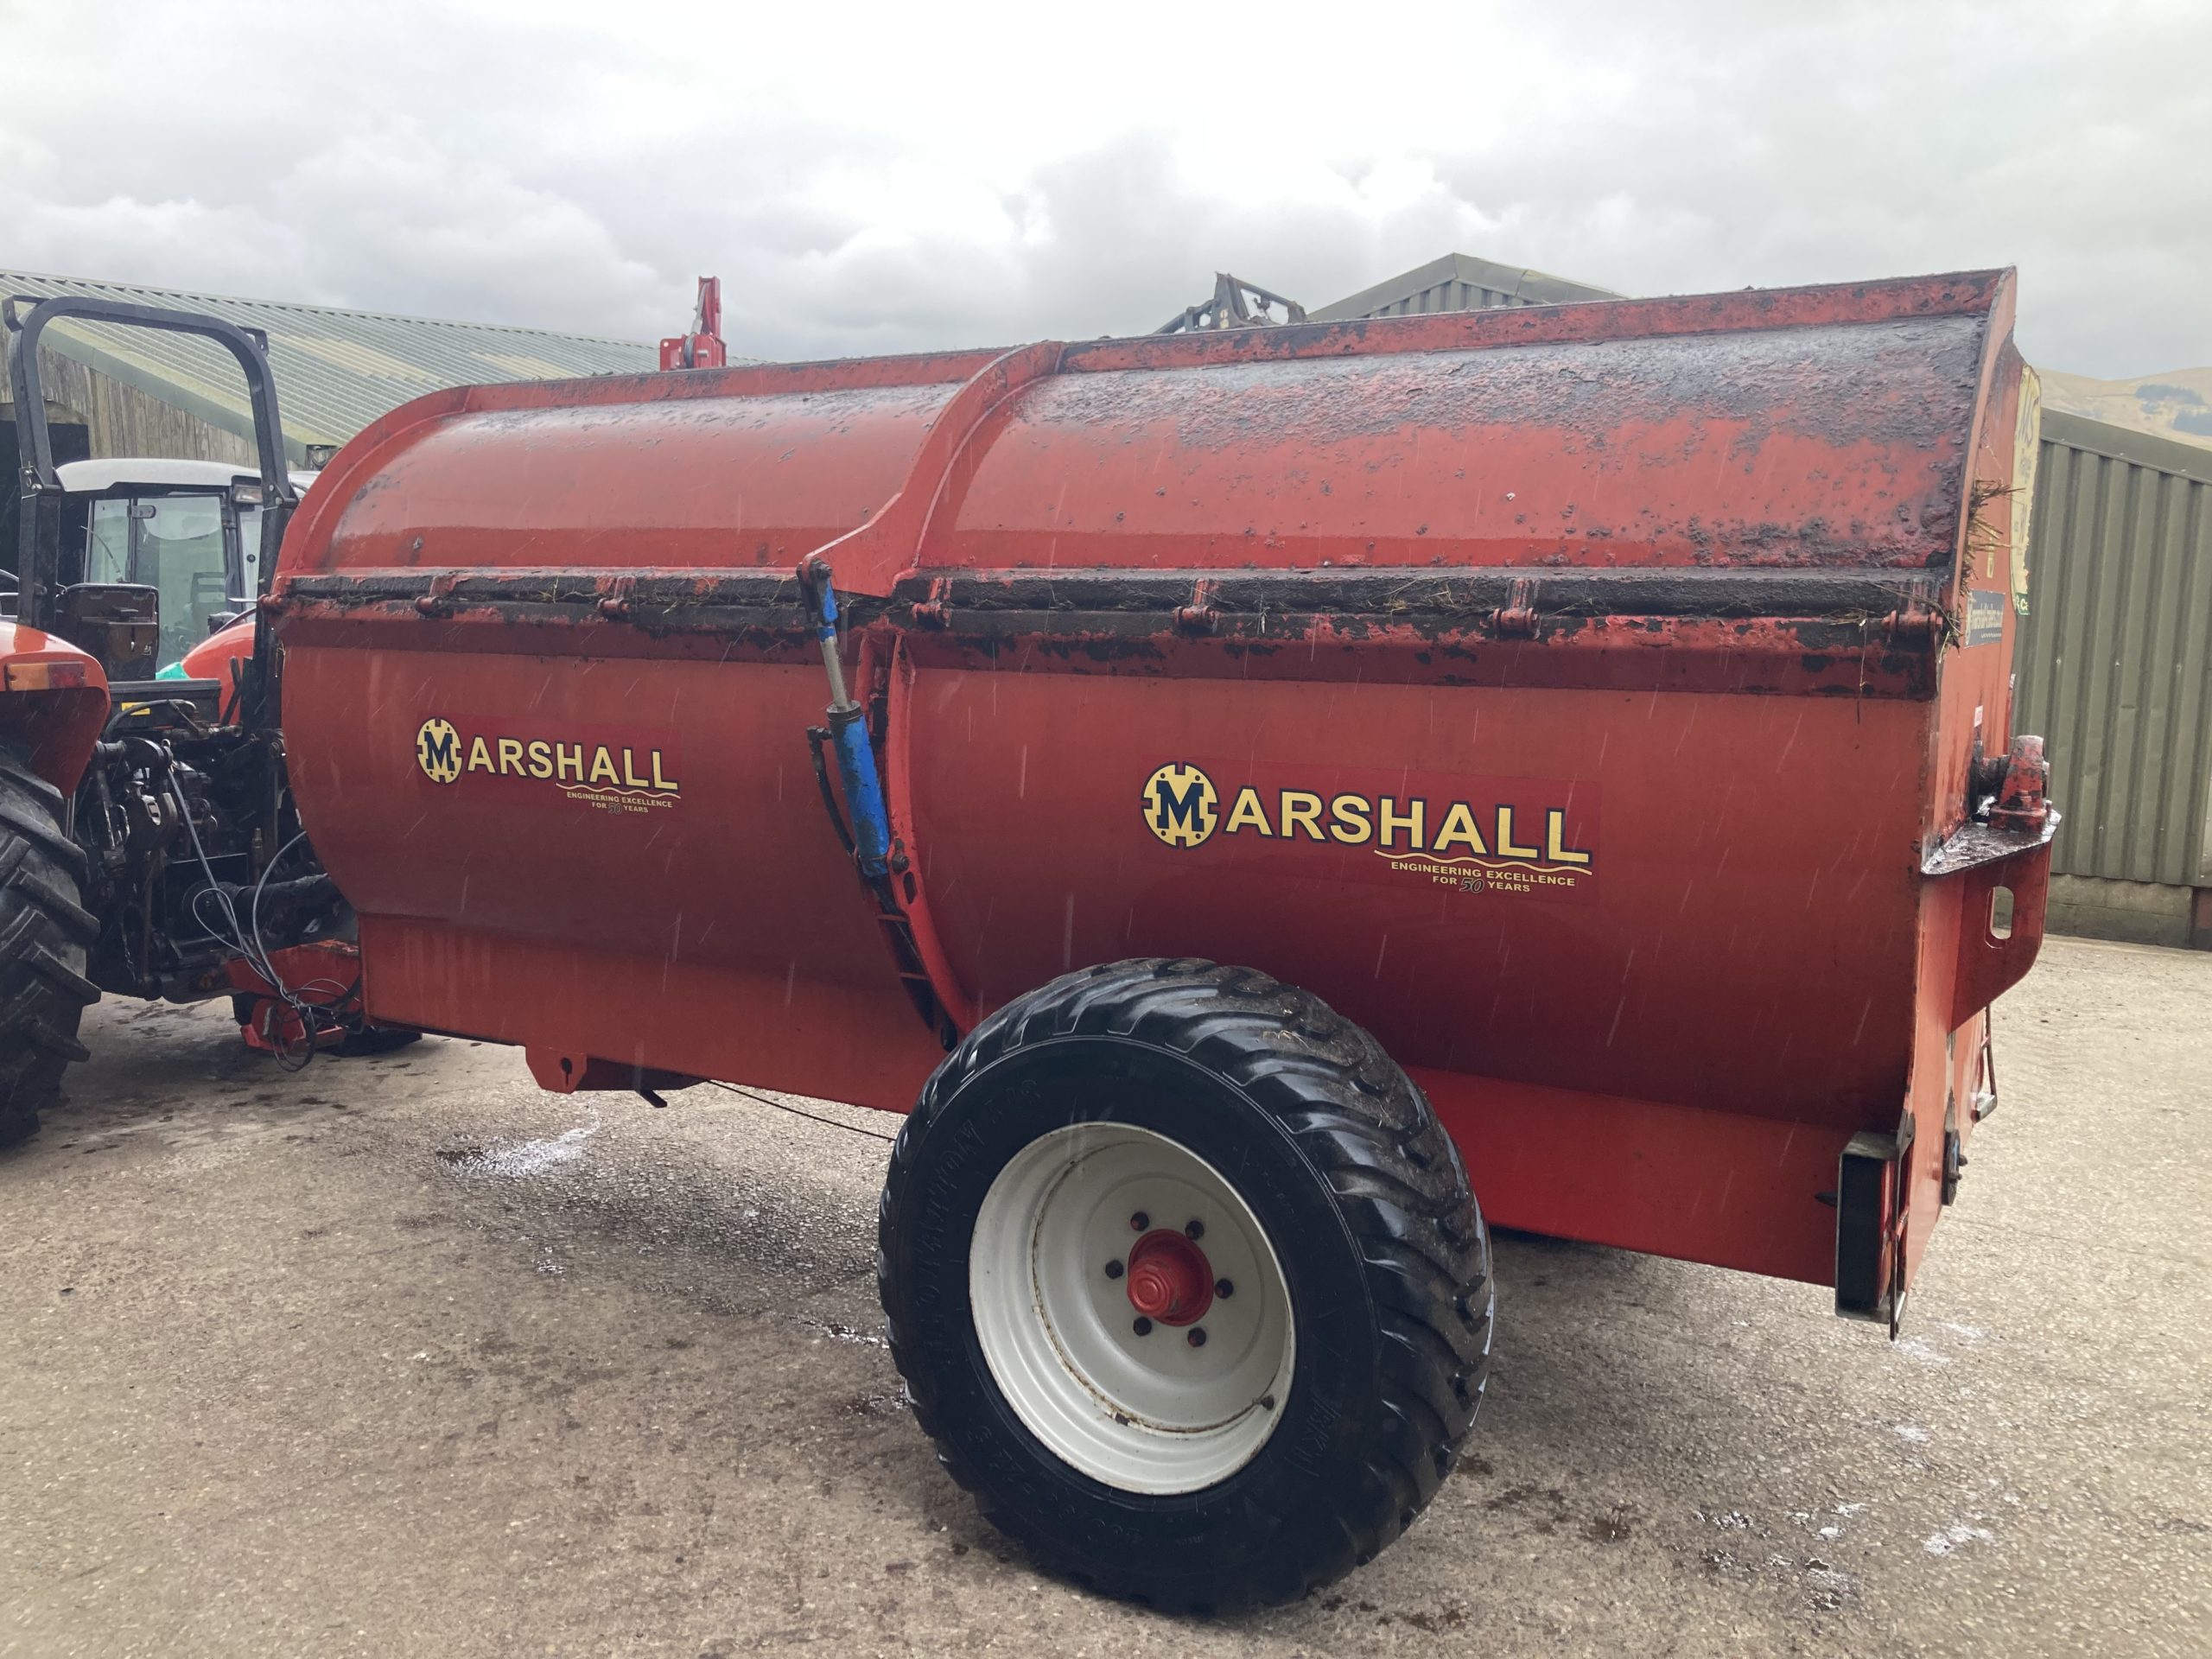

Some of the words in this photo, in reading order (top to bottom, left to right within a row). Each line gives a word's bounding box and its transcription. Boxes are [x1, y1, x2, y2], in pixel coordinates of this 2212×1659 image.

[419, 724, 680, 791] MARSHALL
[566, 791, 620, 802] ENGINEERING
[621, 797, 673, 808] EXCELLENCE
[607, 803, 623, 815] 50
[623, 804, 649, 813] YEARS
[1149, 774, 1591, 864] MARSHALL
[1391, 861, 1482, 877] ENGINEERING
[1486, 870, 1575, 887] EXCELLENCE
[1433, 875, 1458, 885] FOR
[1459, 878, 1485, 893] 50
[1487, 881, 1530, 893] YEARS
